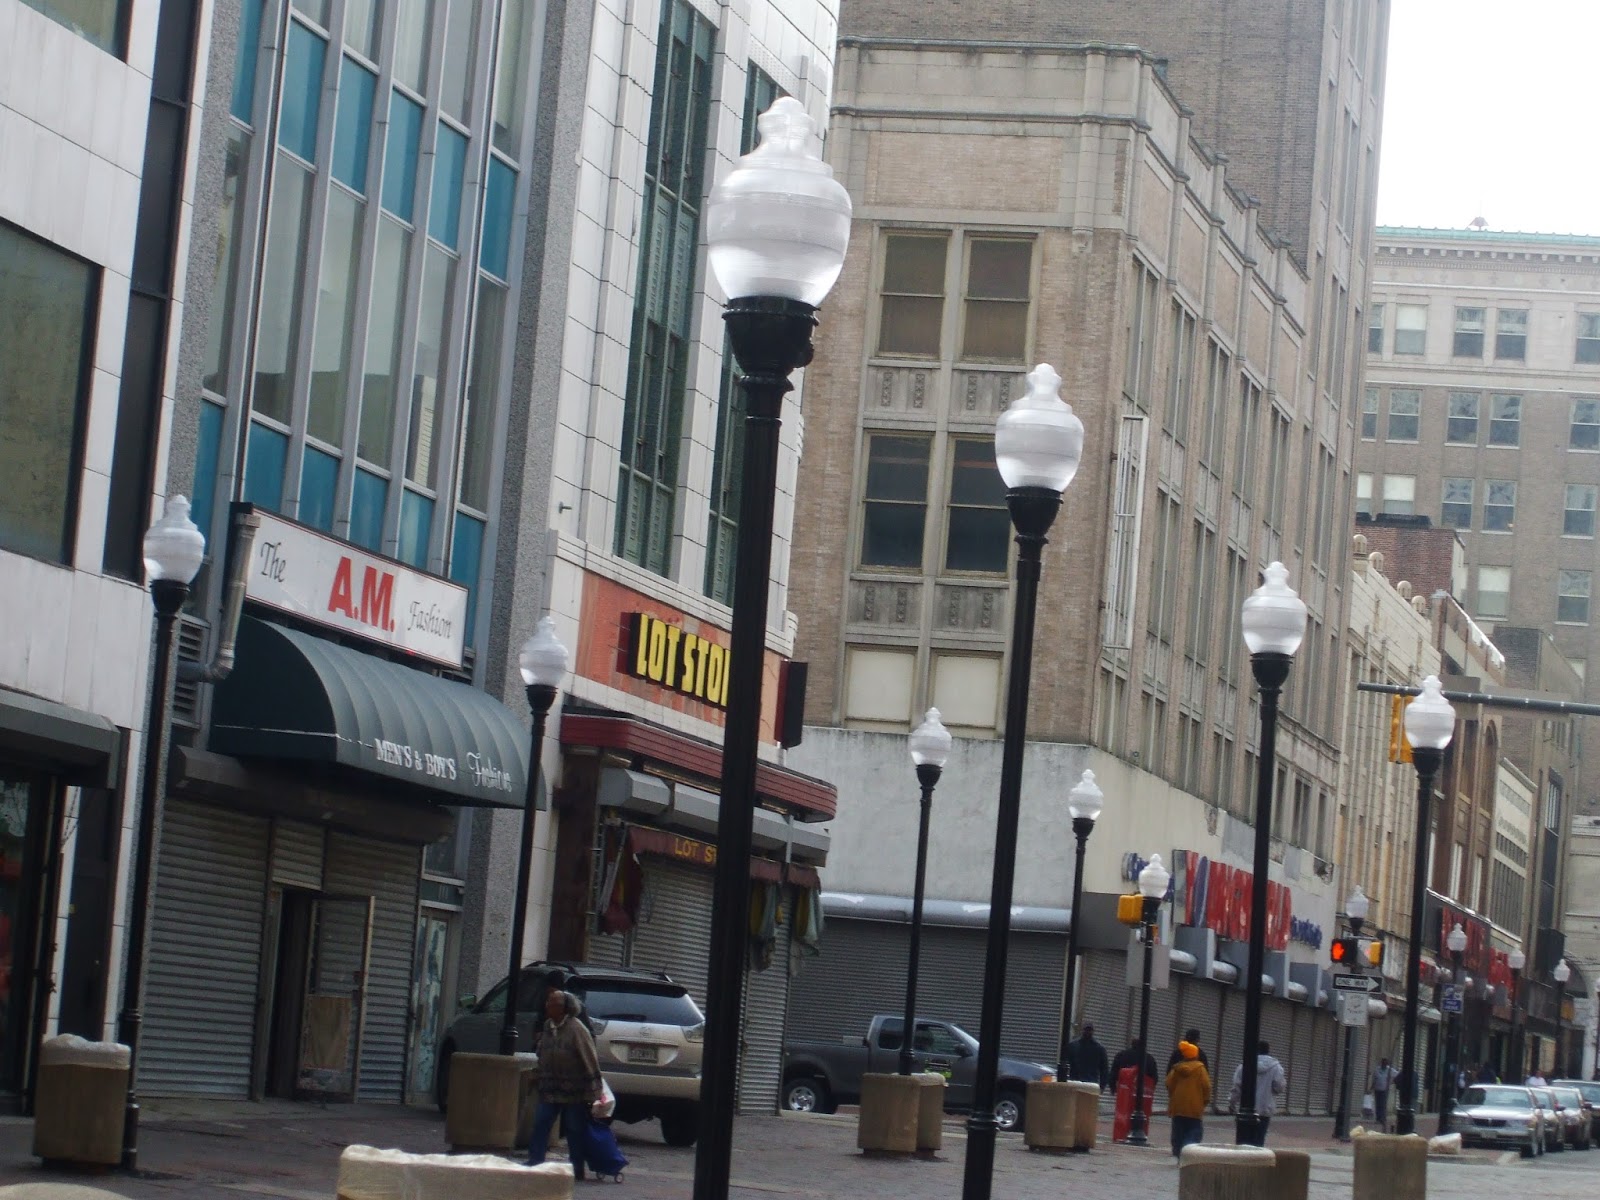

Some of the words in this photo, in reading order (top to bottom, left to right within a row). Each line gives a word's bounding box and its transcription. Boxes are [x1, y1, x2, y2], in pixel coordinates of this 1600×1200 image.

[261, 541, 286, 583] The
[328, 556, 395, 633] A.M.
[407, 600, 452, 639] Fashion
[636, 613, 680, 686] LOT
[374, 738, 412, 768] MEN'S
[414, 751, 423, 771] &
[425, 753, 457, 780] BOY'S
[675, 837, 699, 857] LOT
